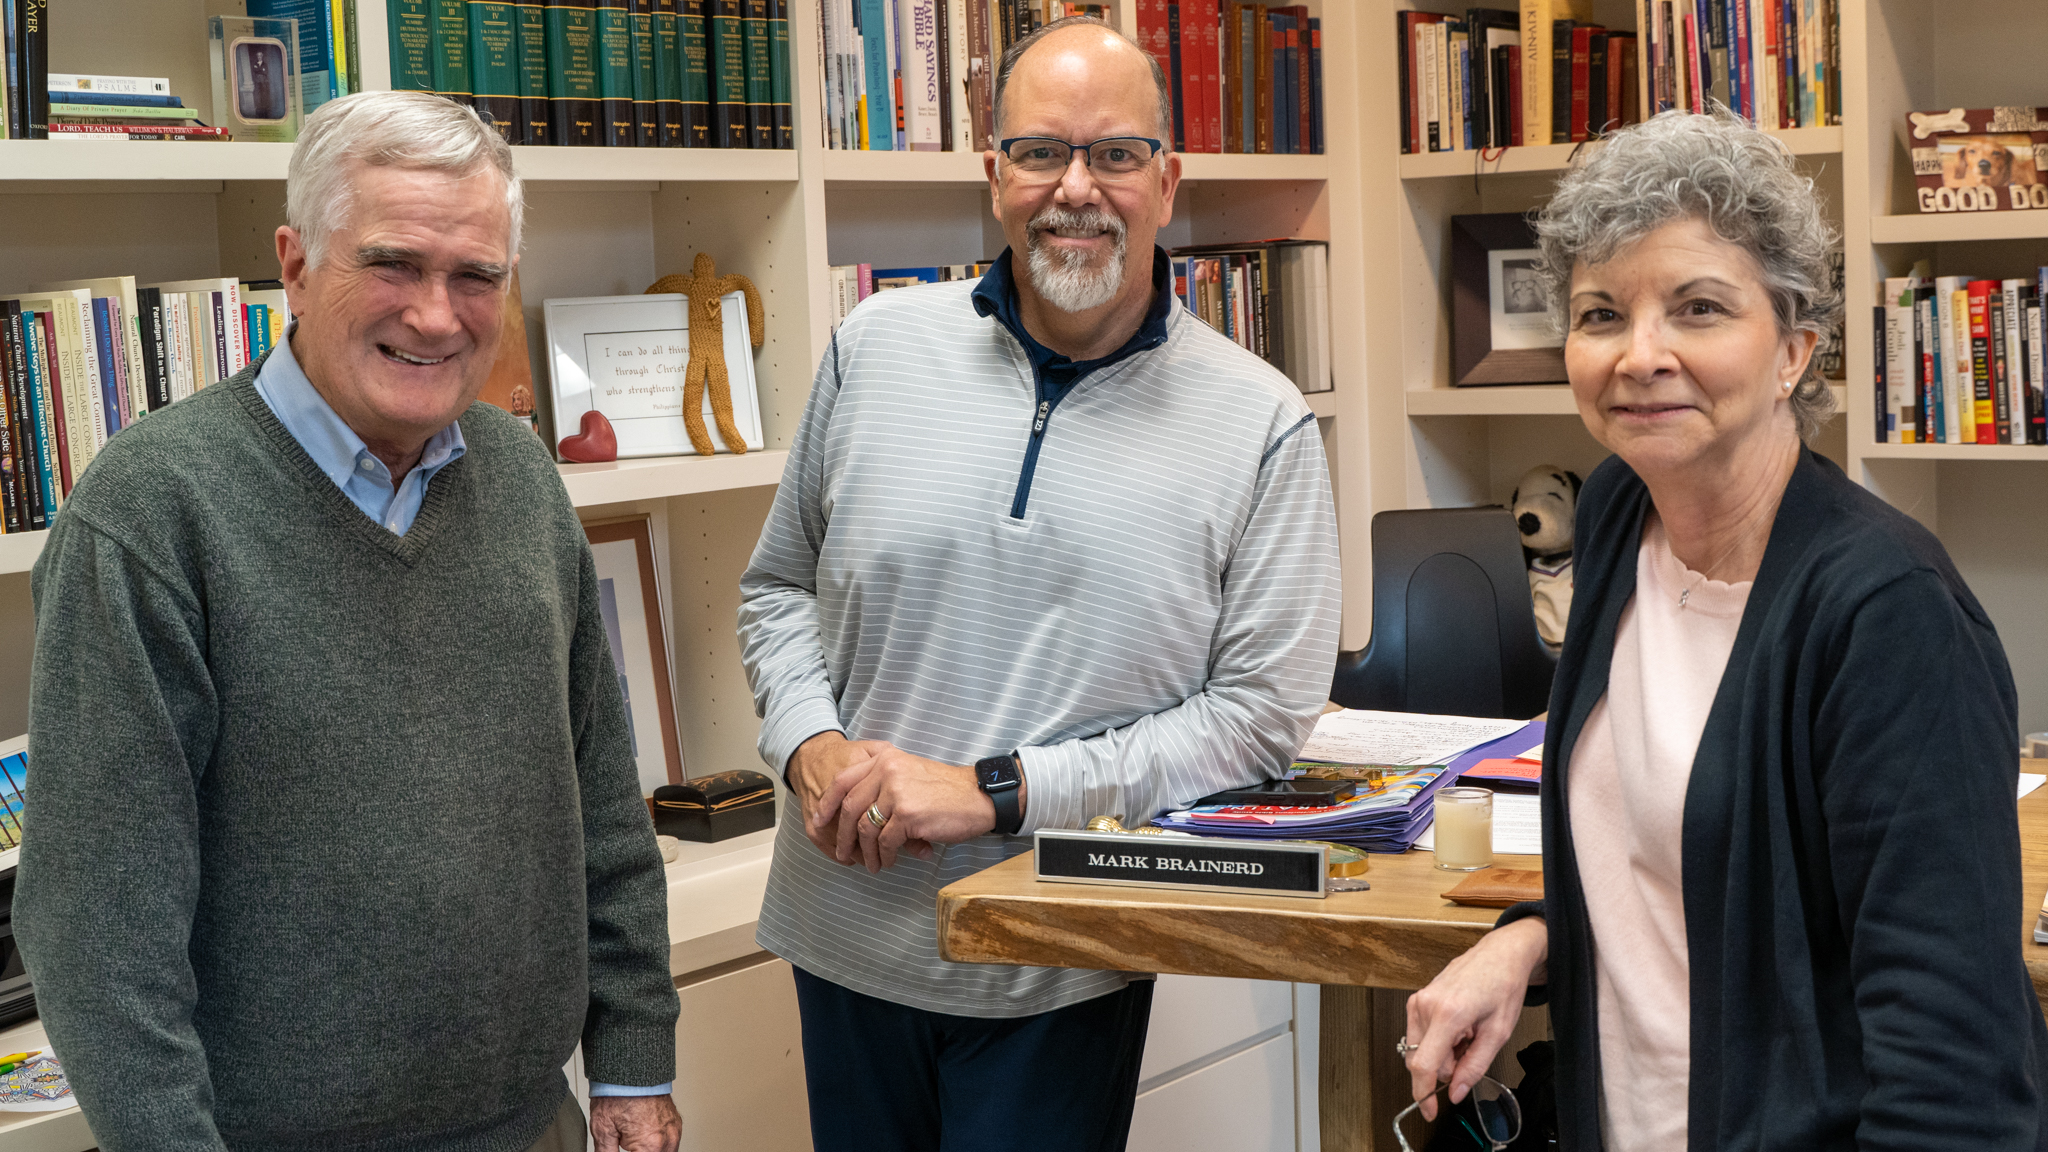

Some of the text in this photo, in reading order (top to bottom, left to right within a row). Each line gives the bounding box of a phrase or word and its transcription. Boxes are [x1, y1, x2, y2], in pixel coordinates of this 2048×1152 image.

[914, 5, 925, 50] BIBLE
[925, 39, 936, 102] SAYINGS
[1426, 28, 1435, 90] How We Die
[872, 62, 881, 90] Preaching
[57, 124, 82, 133] LORD,
[1918, 185, 1998, 212] GOOD
[151, 306, 163, 340] Paradigm
[2004, 290, 2016, 331] APPRECIATE
[28, 320, 37, 351] Twelve
[193, 306, 201, 348] Professional
[232, 309, 240, 350] DISCOVER
[1886, 319, 1899, 362] Picoult
[1898, 331, 1906, 350] Jodi
[80, 302, 100, 399] Reclaiming the Great
[106, 338, 111, 348] Do
[156, 342, 164, 359] Shift
[219, 336, 227, 380] Turnaround
[605, 348, 610, 357] I
[638, 347, 647, 355] do
[652, 346, 663, 355] all
[2028, 313, 2040, 383] Nickel Dimed
[11, 314, 29, 420] Natural Church Development
[30, 352, 40, 374] Keys
[38, 349, 47, 373] Multiple
[62, 351, 72, 381] INSIDE
[70, 302, 78, 336] BEAUMONT
[74, 349, 84, 379] INSIDE
[79, 394, 89, 422] LARGE
[129, 314, 137, 337] Natural
[134, 364, 144, 404] Development
[616, 363, 685, 377] through Christ
[35, 375, 41, 385] to
[36, 386, 42, 397] an
[159, 377, 168, 402] Church
[606, 386, 622, 396] who
[628, 384, 675, 396] strengthens
[8, 370, 16, 395] Dynamic
[14, 422, 23, 458] Transforming
[38, 400, 48, 437] Effective
[66, 395, 76, 424] LARGE
[1, 430, 11, 452] Side
[42, 439, 51, 471] Church
[1088, 853, 1265, 876] MARK BRAINERD
